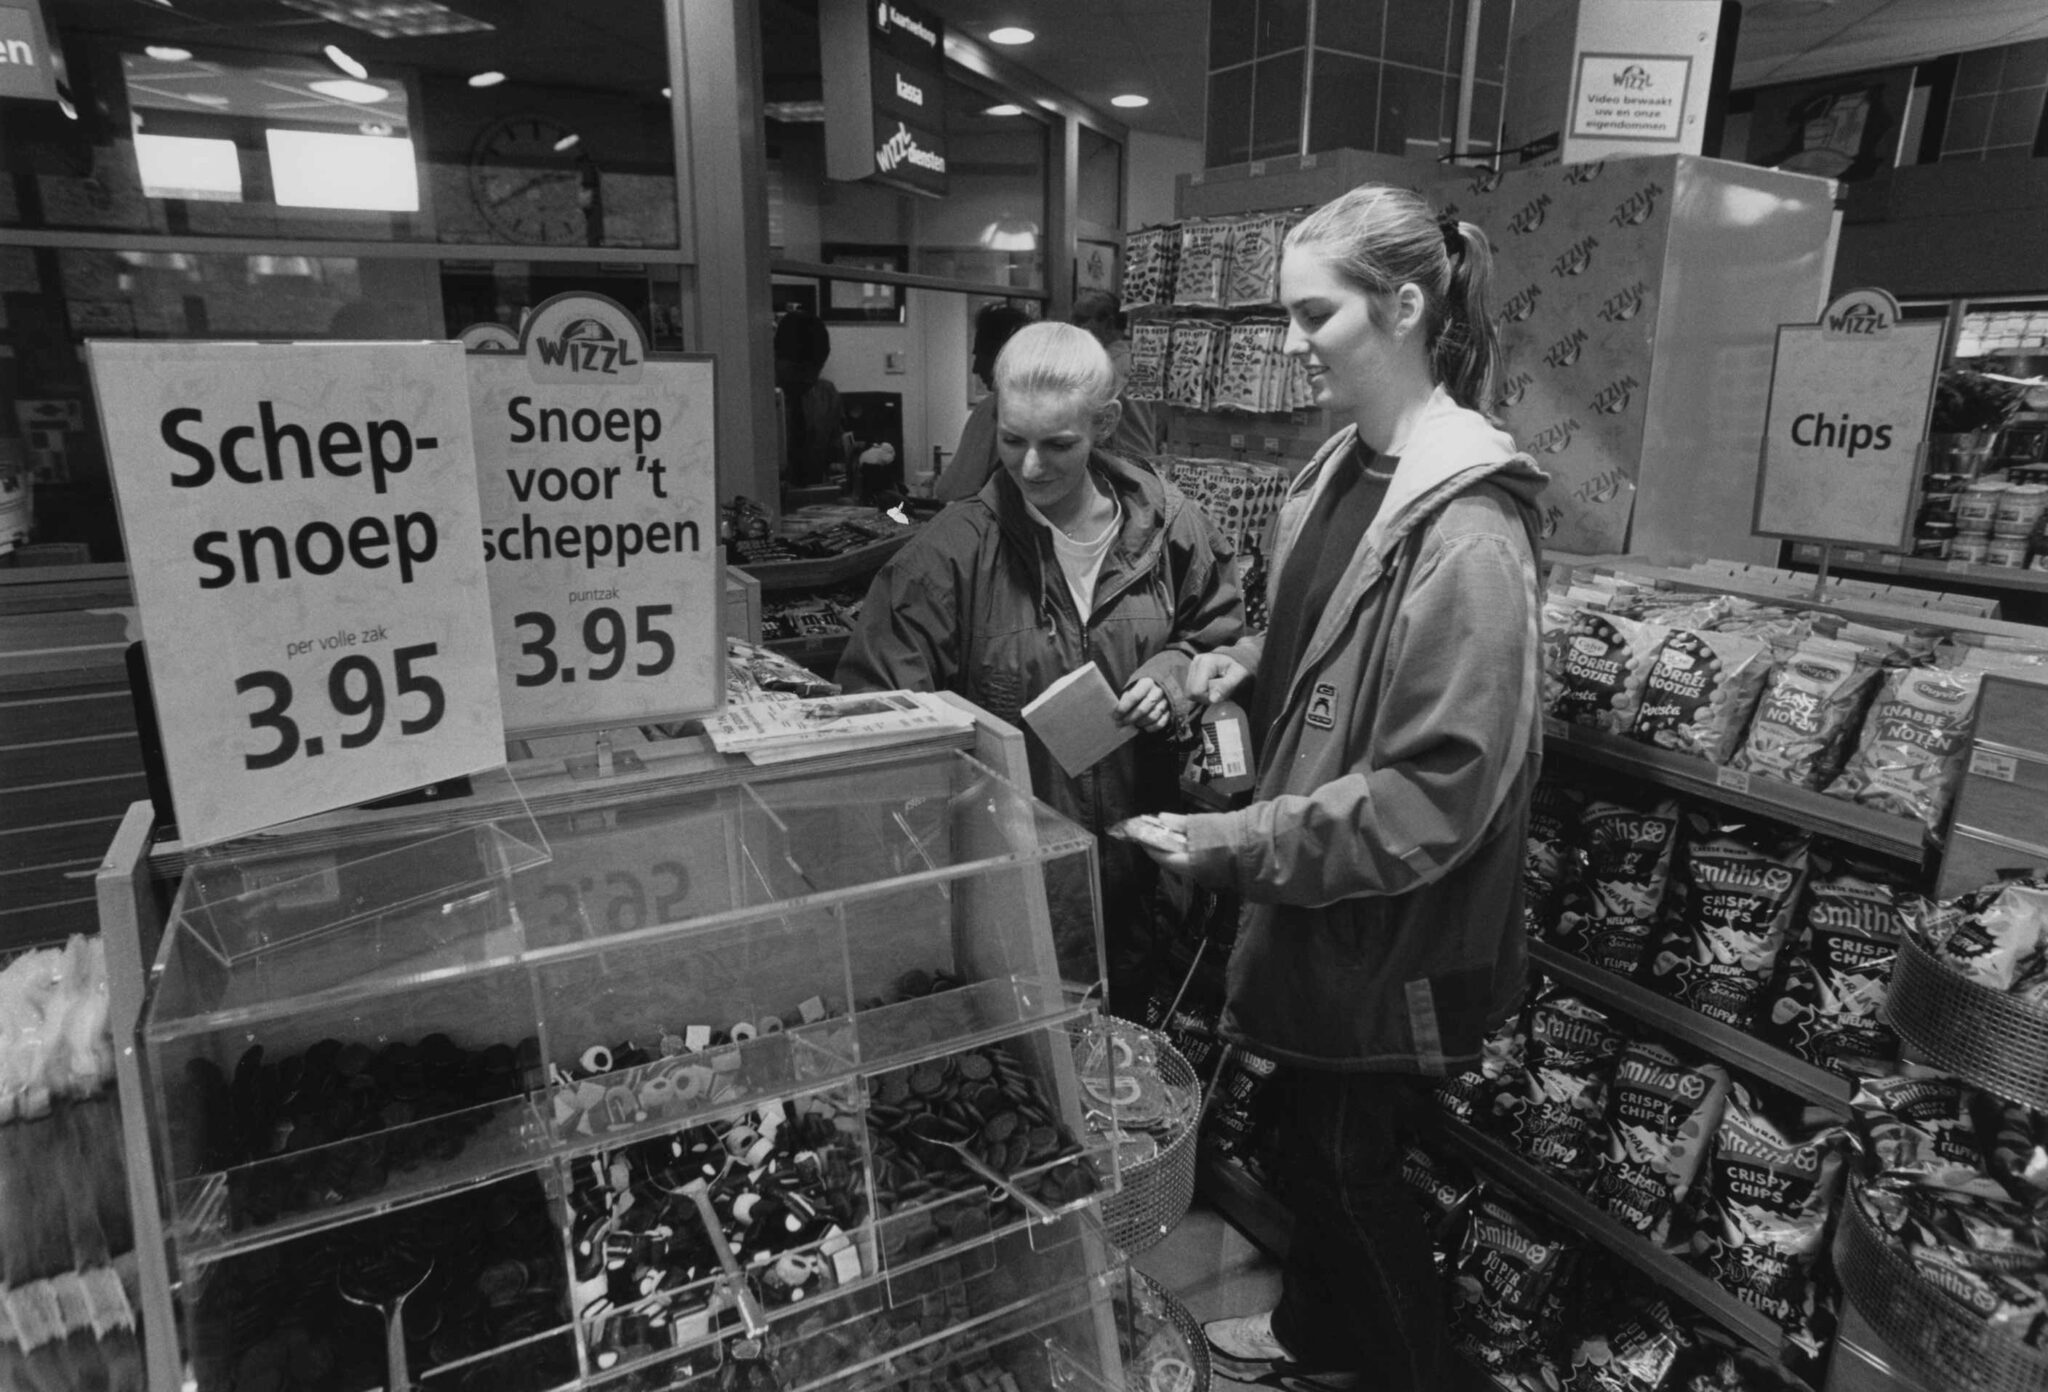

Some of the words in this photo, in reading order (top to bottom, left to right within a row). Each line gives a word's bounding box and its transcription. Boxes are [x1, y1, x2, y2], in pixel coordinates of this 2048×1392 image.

[1612, 71, 1654, 91] WIZZL
[1587, 93, 1620, 106] Video
[1622, 94, 1673, 107] bewaakt
[1595, 107, 1613, 118] uw
[1615, 108, 1631, 118] en
[1633, 108, 1662, 119] onze
[1585, 119, 1667, 132] eigendommen
[1828, 313, 1889, 335] WIZZL
[536, 335, 638, 374] WIZZL
[507, 396, 662, 454] Snoep
[1790, 411, 1893, 459] Chips
[160, 401, 438, 494] Schep-
[506, 463, 621, 502] voor
[192, 509, 439, 590] snoep
[482, 514, 700, 569] scheppen
[567, 587, 620, 605] puntzak
[286, 637, 314, 659] per
[318, 630, 358, 652] volle
[361, 625, 388, 644] zak
[512, 604, 677, 688] 3.95
[1567, 648, 1622, 675] BORREL
[1653, 662, 1707, 689] BORREL
[234, 642, 446, 770] 3.95
[1688, 859, 1763, 887] Smiths
[1702, 895, 1762, 911] CRISPY
[1702, 905, 1752, 924] CHIPS
[1812, 900, 1902, 936] Smiths
[1532, 1010, 1602, 1048] Smiths
[1619, 1091, 1674, 1112] CRISPY
[1884, 1082, 1938, 1110] Smiths
[1619, 1105, 1666, 1126] CHIPS
[1726, 1165, 1793, 1190] CRISPY
[1730, 1180, 1784, 1204] CHIPS
[1478, 1219, 1532, 1255] Smiths
[1914, 1259, 1974, 1301] Smiths
